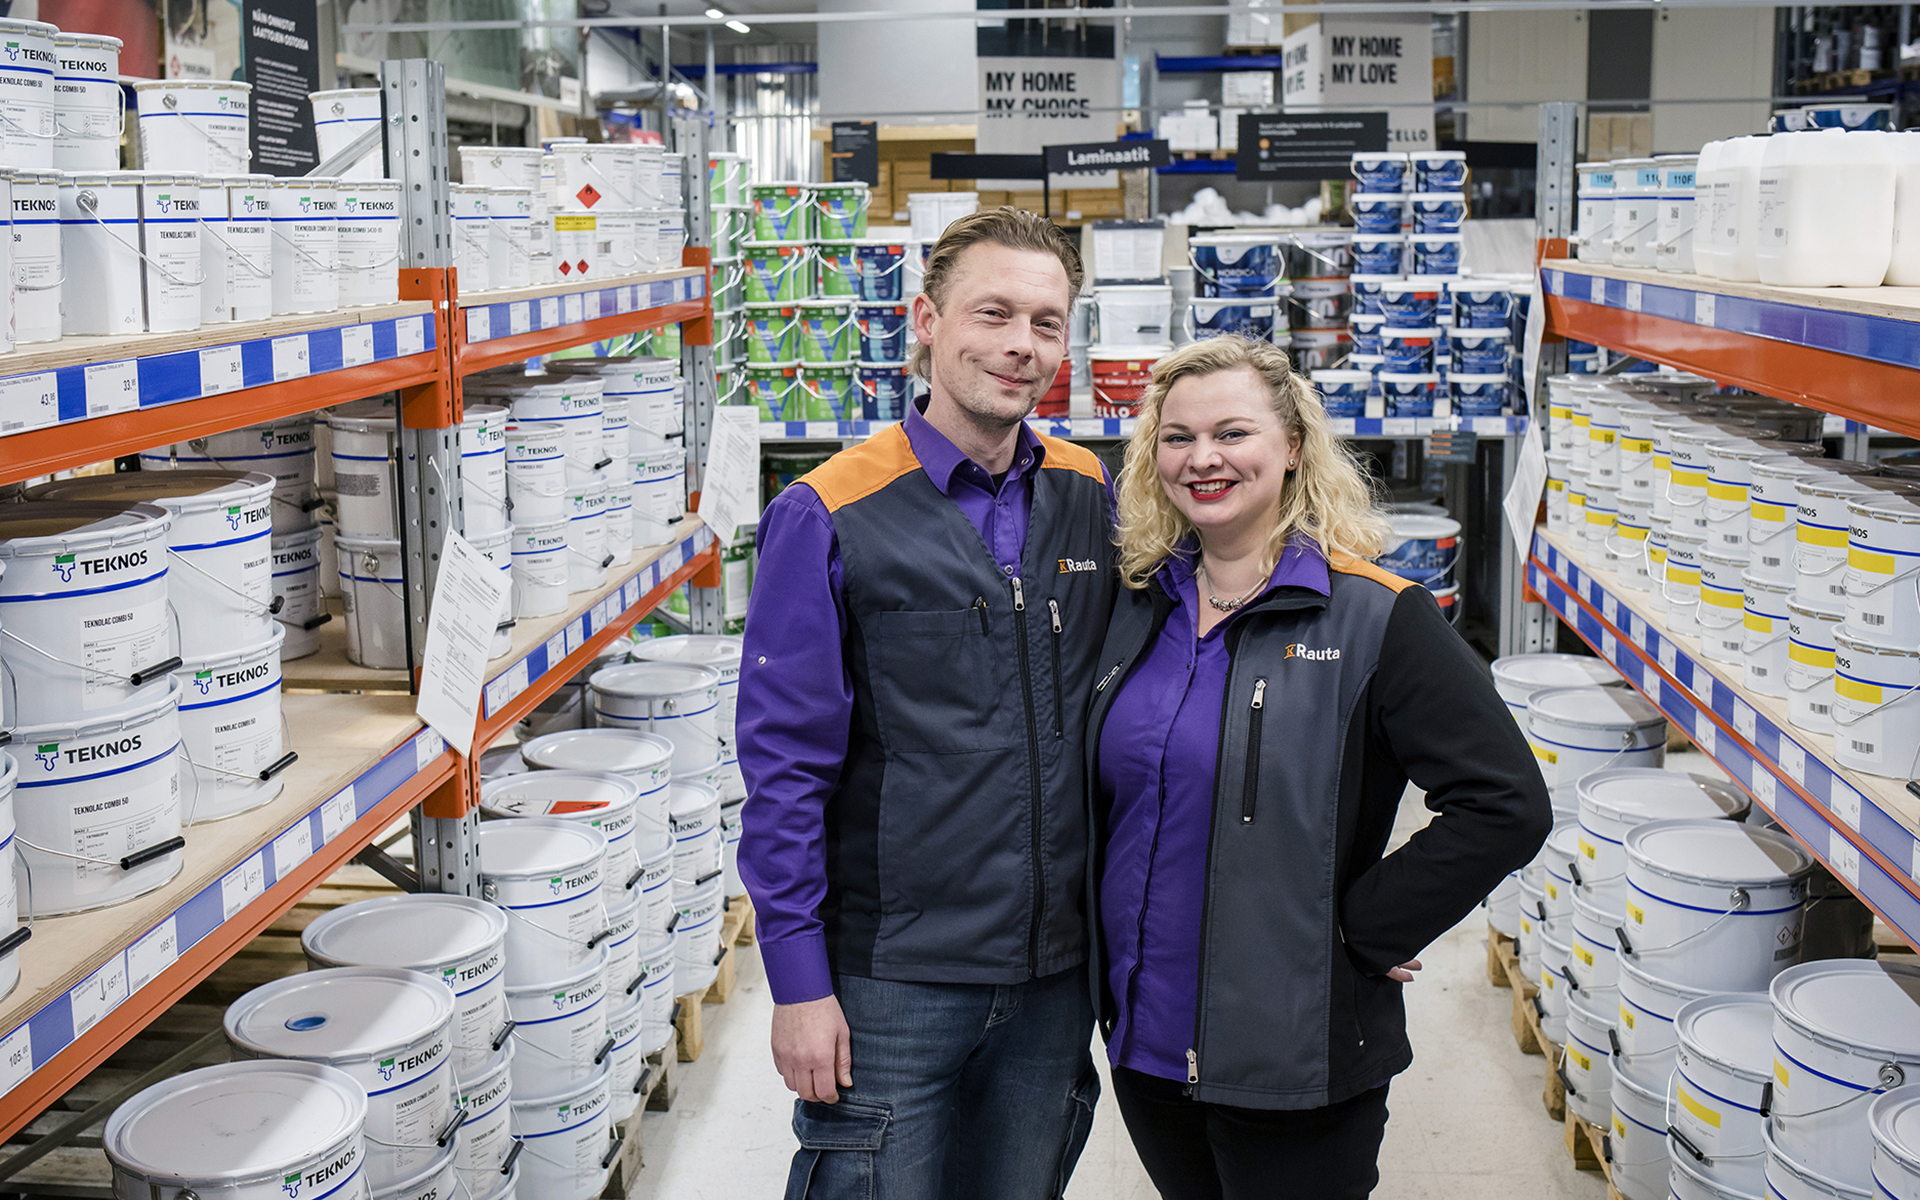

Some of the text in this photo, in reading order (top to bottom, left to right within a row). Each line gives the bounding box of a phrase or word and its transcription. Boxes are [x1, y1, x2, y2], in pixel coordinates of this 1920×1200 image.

[1332, 36, 1402, 57] MY HOME
[59, 59, 107, 72] TEKNOS
[1332, 63, 1397, 83] MY LOVE
[0, 76, 22, 87] EKNOLAC
[986, 72, 1076, 92] MY HOME
[1022, 99, 1090, 118] CHOICE
[1068, 147, 1150, 166] Laminaatit
[1674, 174, 1693, 184] 110F
[13, 200, 56, 211] TEKNOS
[360, 202, 394, 211] TEKNOS
[13, 234, 22, 243] 50
[573, 398, 600, 409] TEKNOS
[277, 431, 310, 445] TEKNOS
[527, 446, 557, 455] TEKNOS
[538, 536, 564, 546] TEKNOS
[80, 549, 148, 576] TEKNOS
[273, 549, 311, 565] TEKNOS
[1066, 558, 1097, 572] Rauta
[84, 612, 134, 629] TEKNOLAC COMBI 50
[1296, 643, 1340, 660] Rauta
[216, 662, 269, 688] TEKNOS
[214, 722, 238, 734] TEKNOLAC
[64, 735, 142, 764] TEKNOS
[74, 797, 129, 815] TEKNOLAC COMBI 50
[604, 814, 632, 832] TEKNOS
[565, 868, 598, 889] TEKNOS
[646, 864, 671, 881] TEKNOS
[692, 903, 717, 919] TEKNOS
[609, 919, 635, 936] EKNOS
[459, 954, 499, 982] TEKNOS
[569, 982, 602, 1004] TEKNOS
[398, 1040, 444, 1072] TEKNOS
[471, 1078, 507, 1109] TEKNOS
[573, 1091, 606, 1117] TEKNOS
[305, 1146, 357, 1188] TEKNOS
